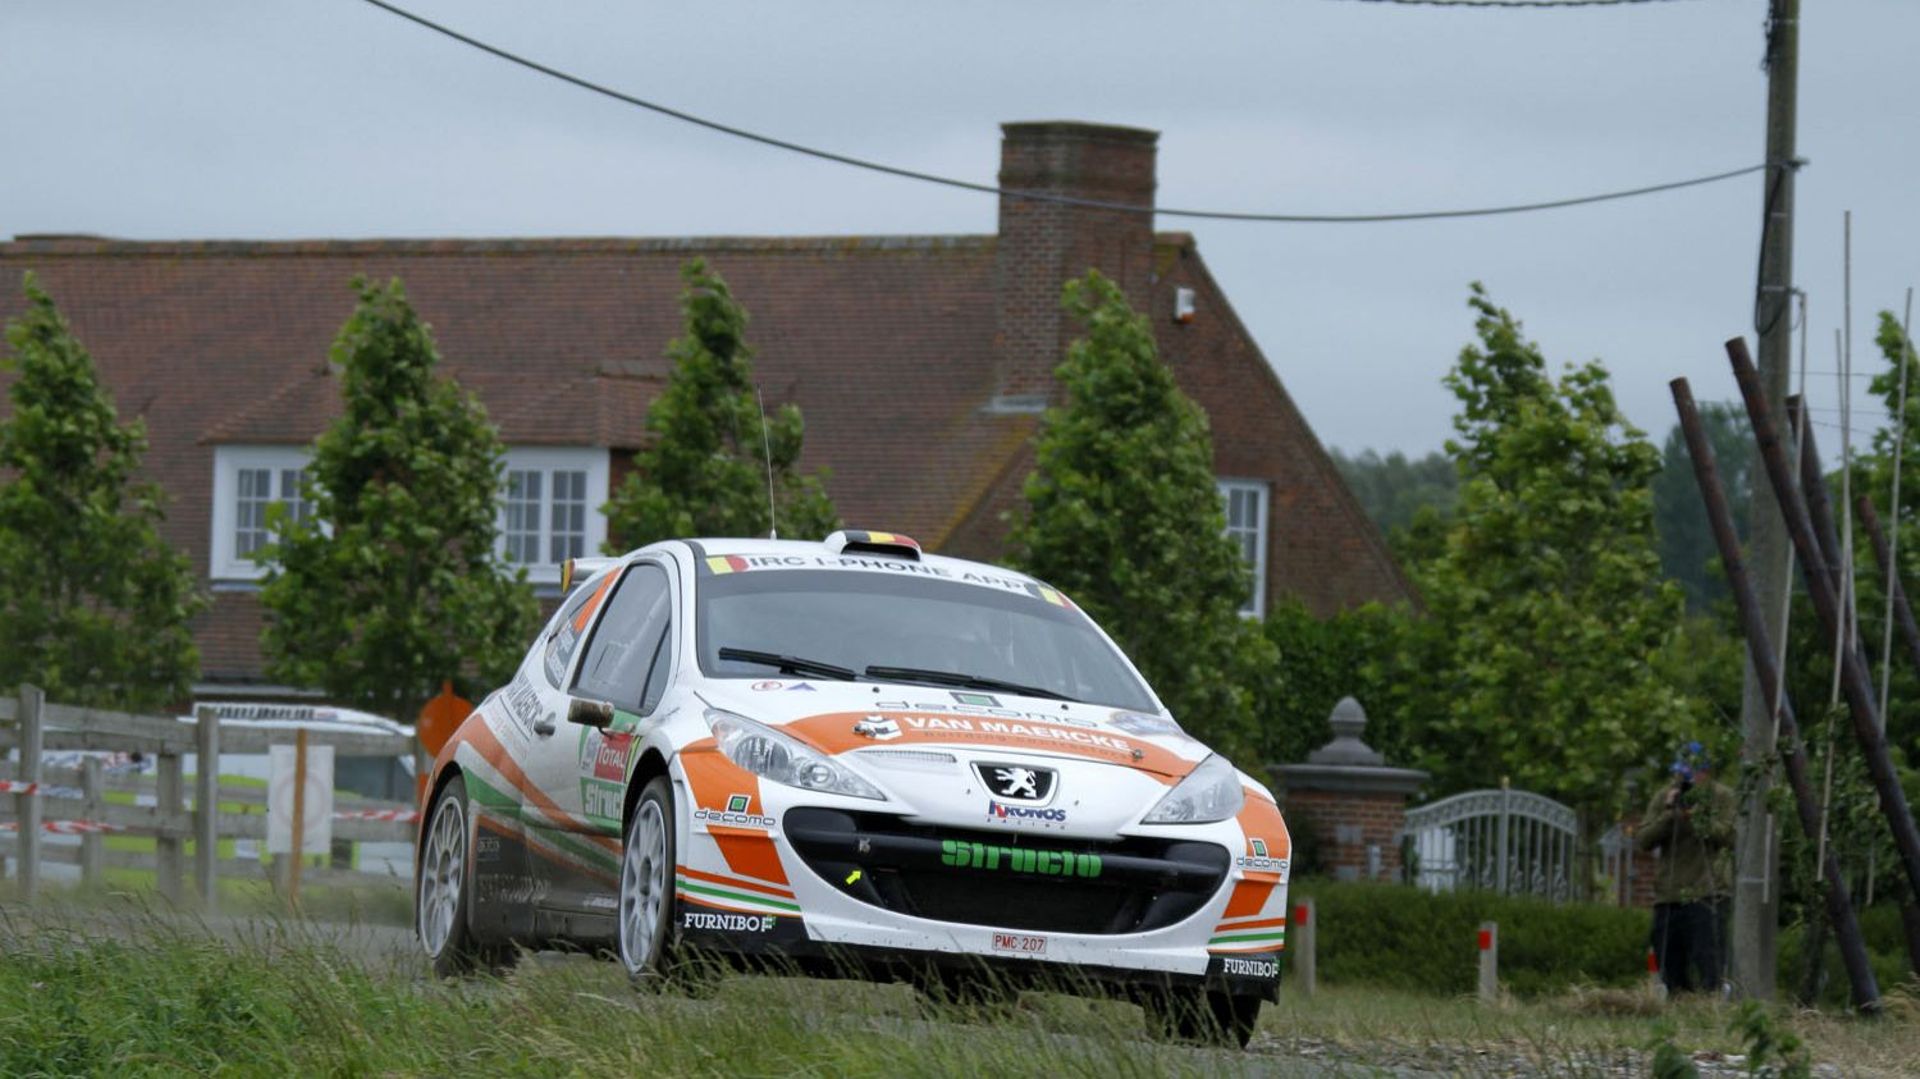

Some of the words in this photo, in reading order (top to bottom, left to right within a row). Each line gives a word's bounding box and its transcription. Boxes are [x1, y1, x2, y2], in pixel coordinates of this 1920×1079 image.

[750, 555, 807, 567] IRC
[815, 556, 953, 578] I-PHONE
[904, 716, 974, 731] VAN
[980, 720, 1130, 750] MAERCKE
[598, 743, 625, 769] TOTAL
[694, 809, 776, 826] decomo
[1236, 857, 1288, 869] decomo
[684, 912, 776, 933] FURNIBOF
[995, 934, 1017, 950] PMC
[1022, 937, 1045, 951] 207
[1223, 957, 1280, 978] FURNIBOF
